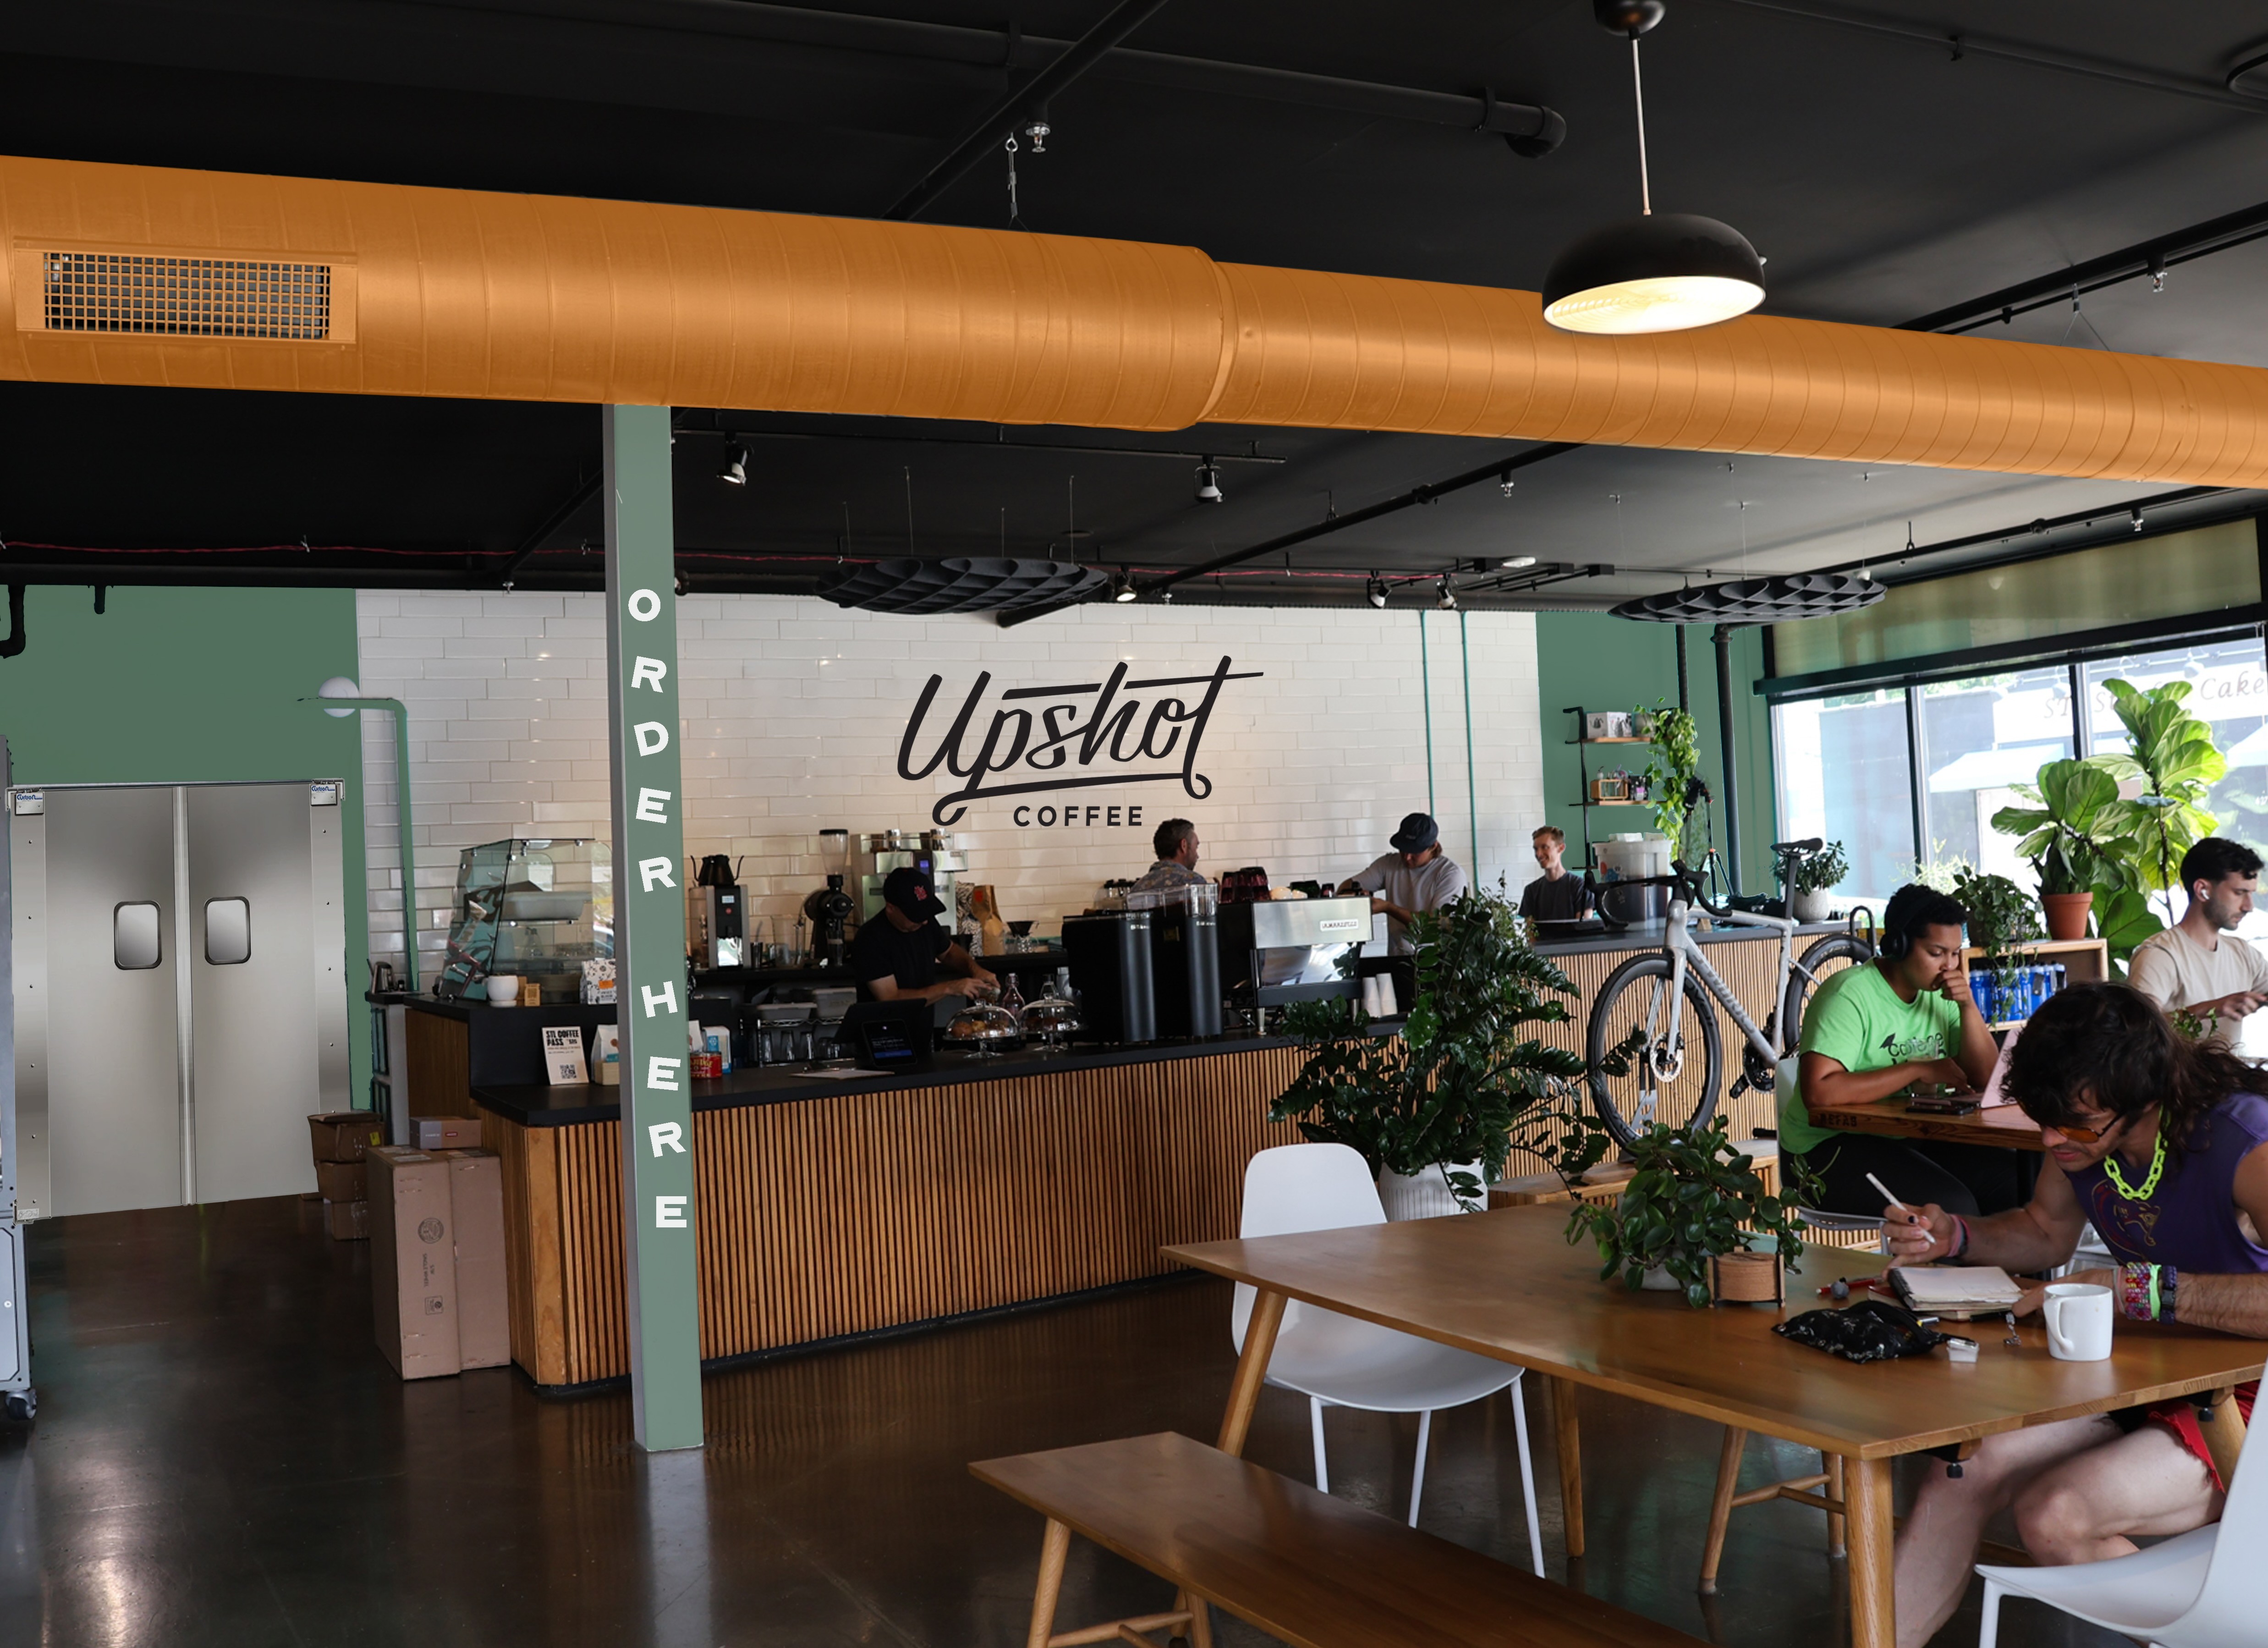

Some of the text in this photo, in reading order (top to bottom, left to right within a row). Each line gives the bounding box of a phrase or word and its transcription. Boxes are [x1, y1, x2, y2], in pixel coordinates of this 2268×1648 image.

[897, 655, 1264, 826] Upshot
[1013, 805, 1142, 827] COFFEE
[628, 589, 687, 1228] ORDER HERE
[547, 1038, 564, 1046] PASS
[557, 1029, 579, 1038] COFFEE
